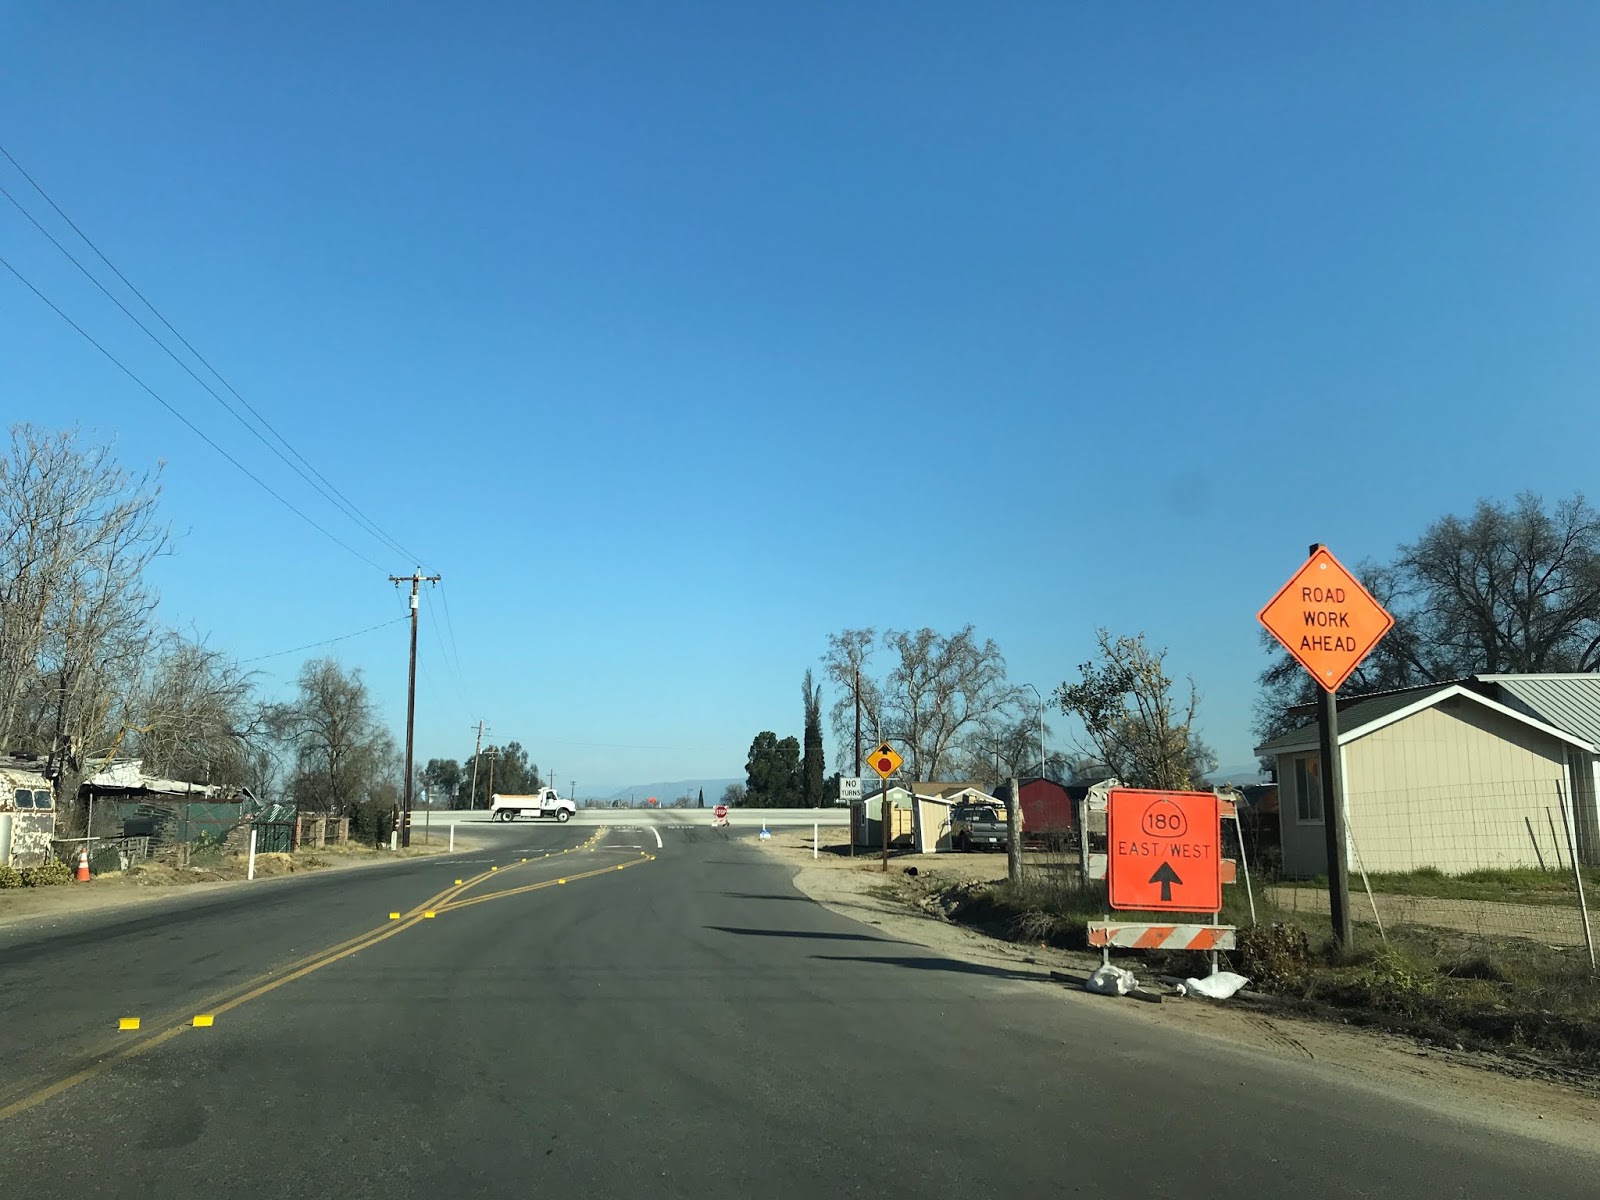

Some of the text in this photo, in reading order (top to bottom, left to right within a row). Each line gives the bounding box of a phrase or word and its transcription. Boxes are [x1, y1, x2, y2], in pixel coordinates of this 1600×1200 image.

[1302, 587, 1346, 603] ROAD
[1303, 610, 1350, 628] WORK
[1300, 635, 1357, 652] AHEAD
[1148, 814, 1180, 830] 180
[1118, 841, 1211, 859] EAST/WEST
